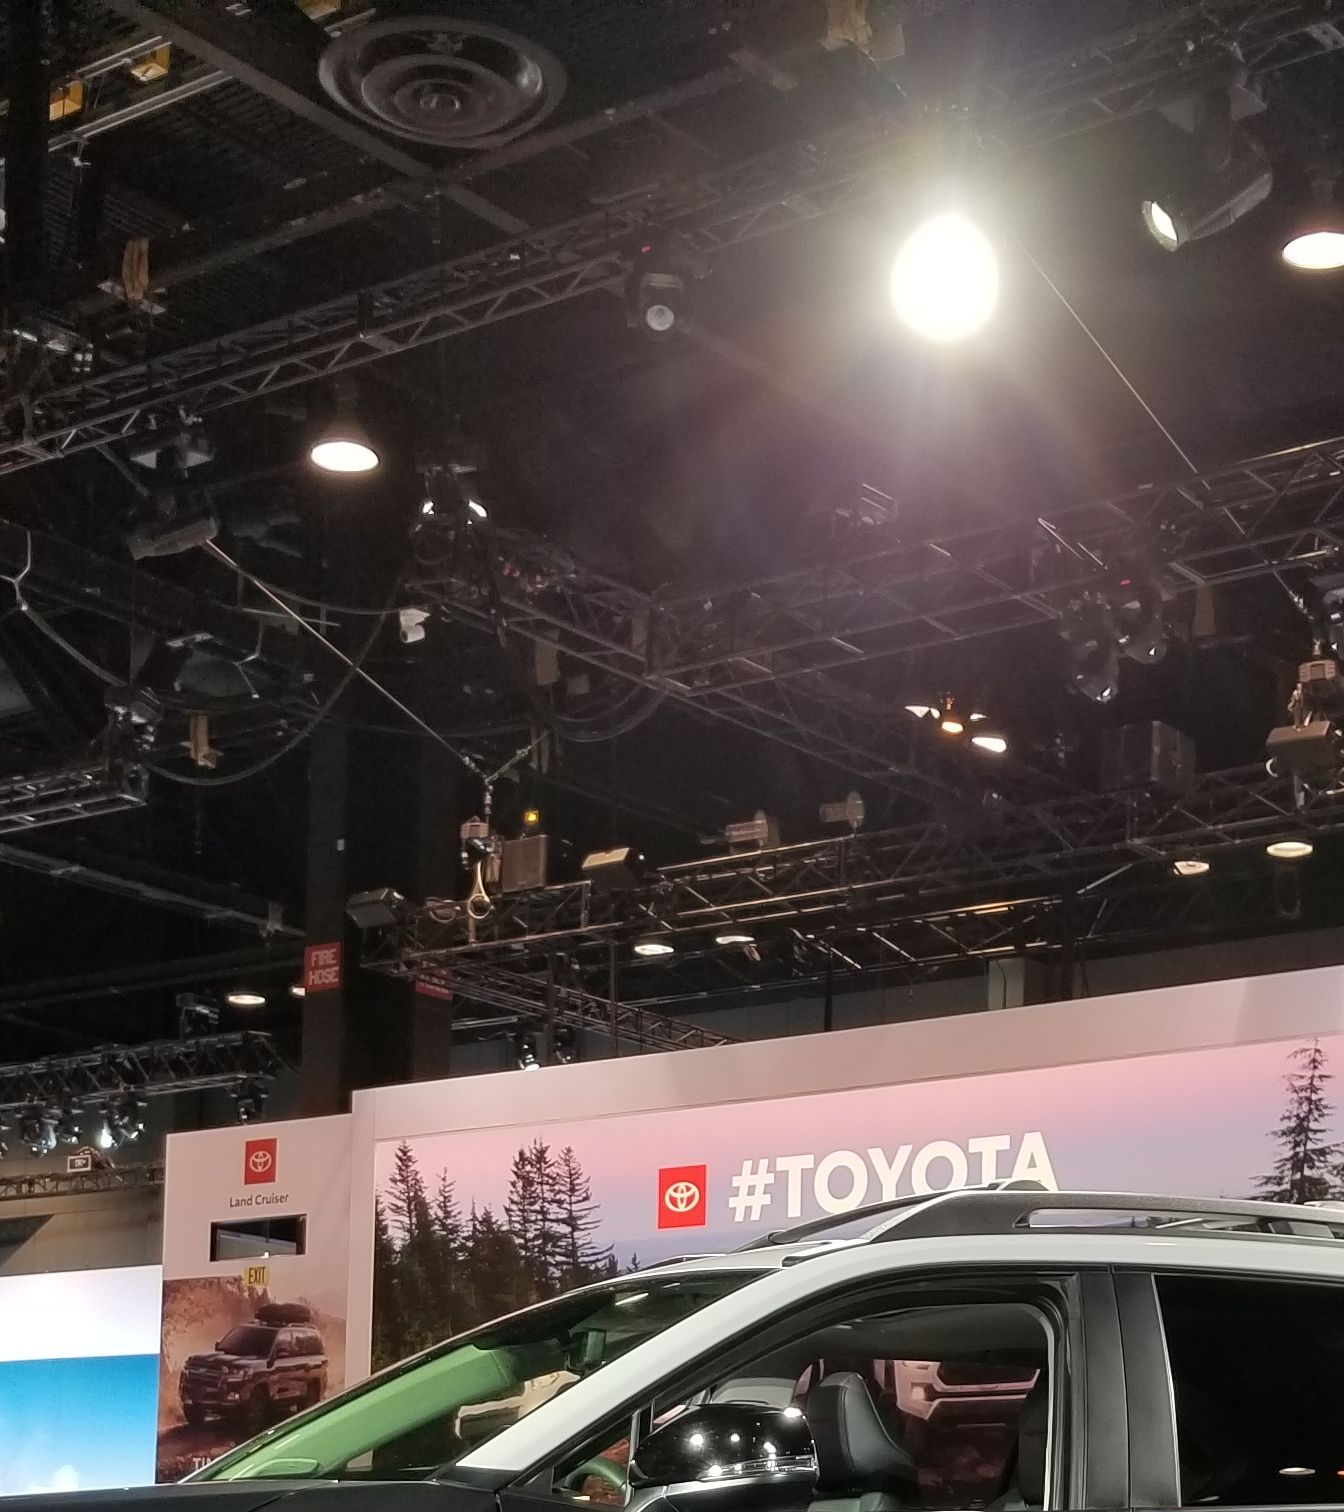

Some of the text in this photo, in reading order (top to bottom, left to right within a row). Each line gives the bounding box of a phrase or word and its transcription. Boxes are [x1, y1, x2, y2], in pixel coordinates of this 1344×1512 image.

[311, 948, 337, 967] FIRE
[308, 966, 340, 985] HOSE
[728, 1131, 1059, 1222] #TOYOTA
[229, 1193, 289, 1208] Land Cruiser
[248, 1266, 266, 1284] EXIT
